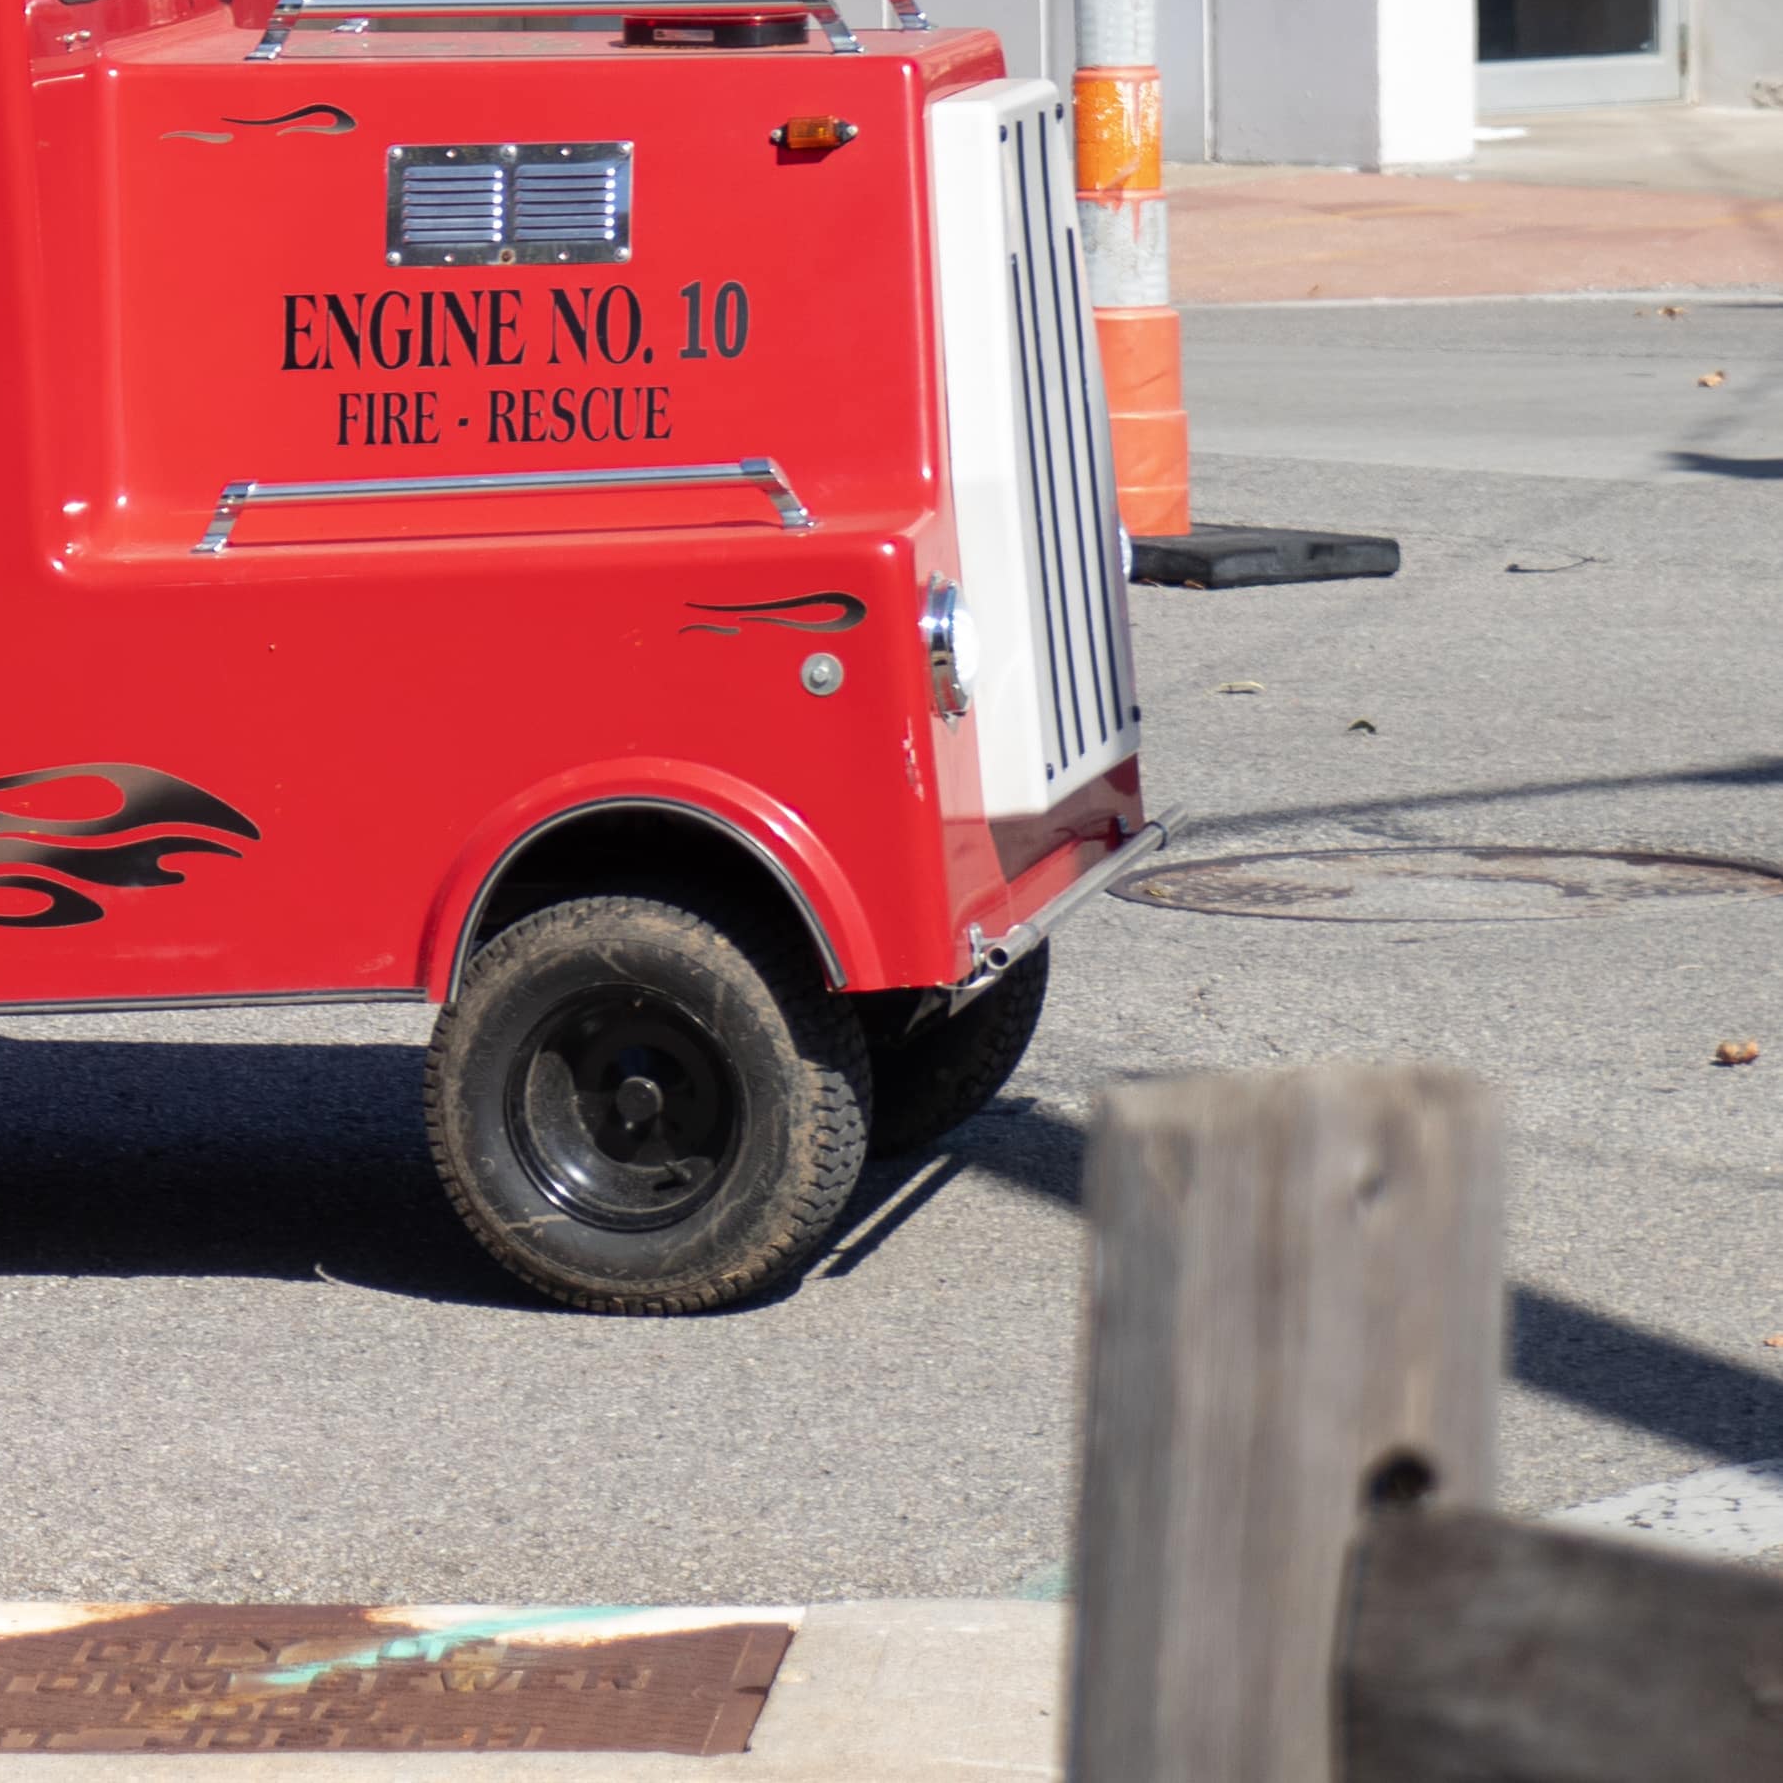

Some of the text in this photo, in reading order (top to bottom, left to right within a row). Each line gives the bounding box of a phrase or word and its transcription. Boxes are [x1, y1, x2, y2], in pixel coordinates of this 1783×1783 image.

[280, 280, 750, 371] ENGINE NO. 10
[336, 390, 441, 446] FIRE
[487, 386, 672, 444] RESCUE
[80, 1638, 295, 1665] CITY
[307, 1668, 647, 1694] SEWER
